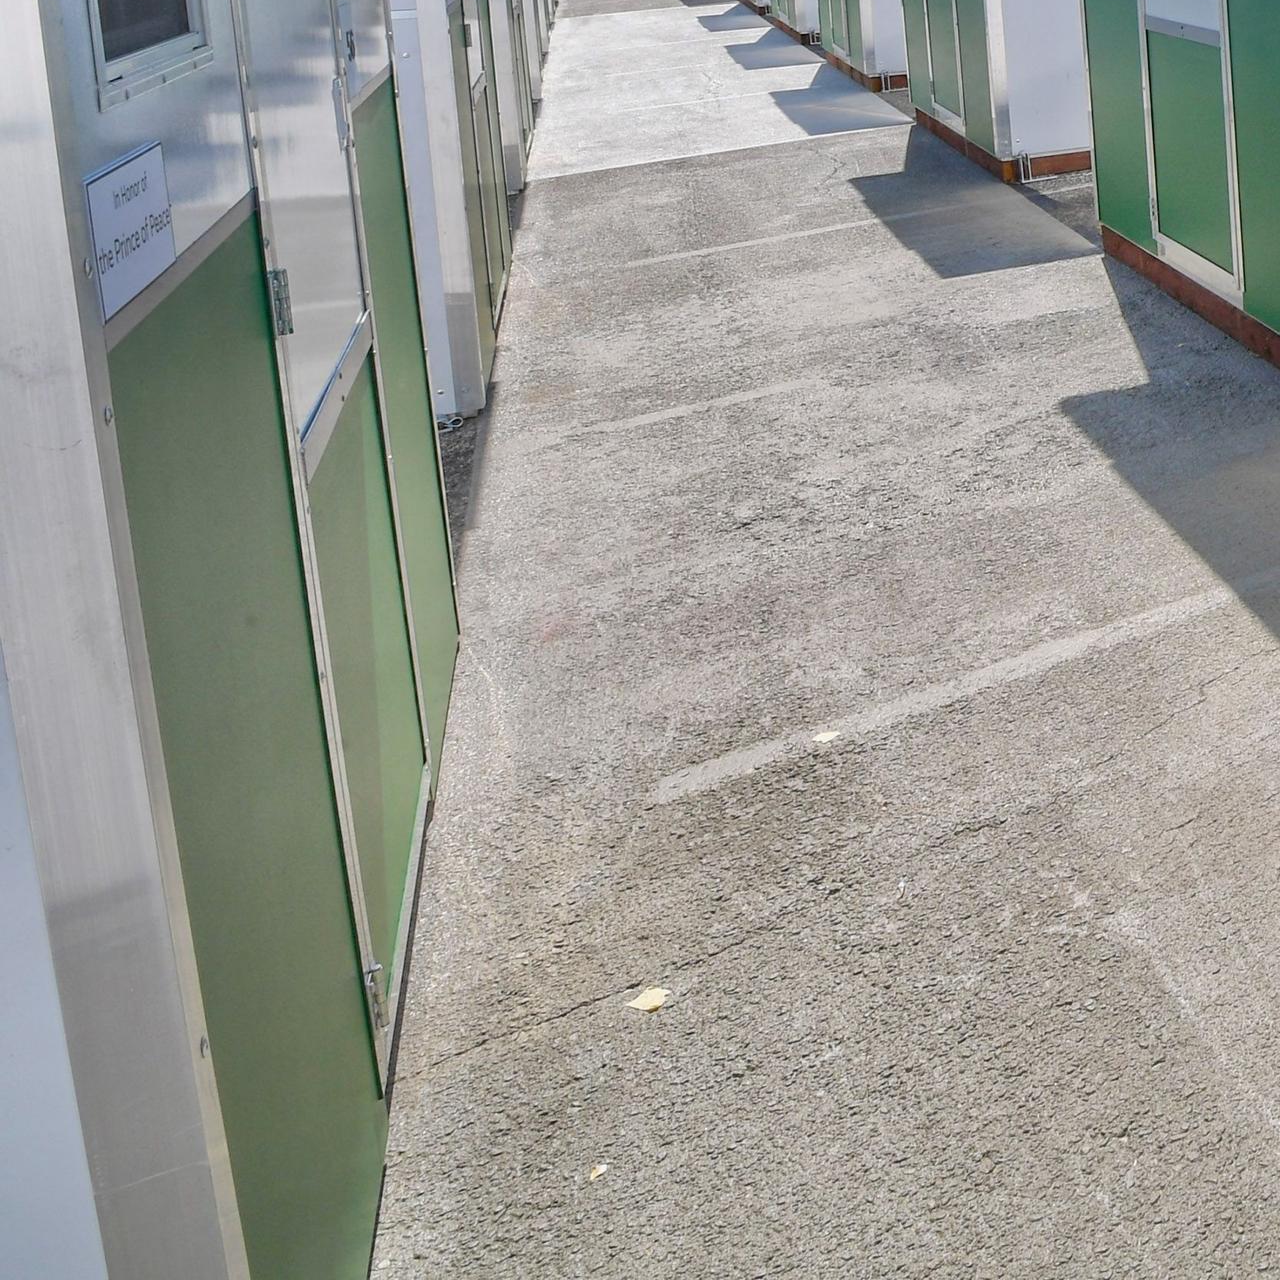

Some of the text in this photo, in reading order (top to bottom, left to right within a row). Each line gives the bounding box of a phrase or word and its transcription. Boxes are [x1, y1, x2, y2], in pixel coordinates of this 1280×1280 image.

[113, 170, 147, 209] In Honor of
[99, 207, 171, 275] the Prince of Peace
